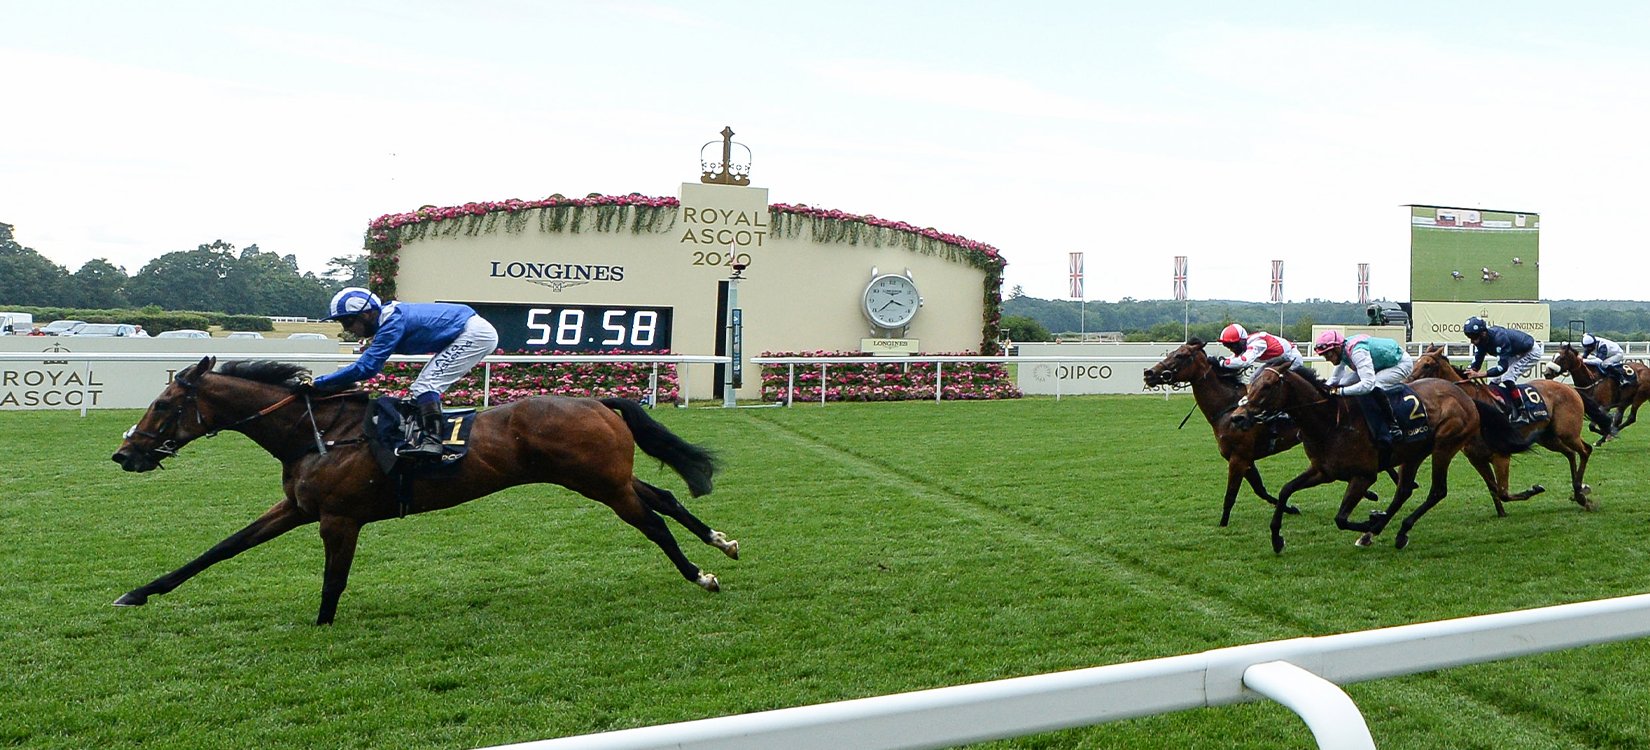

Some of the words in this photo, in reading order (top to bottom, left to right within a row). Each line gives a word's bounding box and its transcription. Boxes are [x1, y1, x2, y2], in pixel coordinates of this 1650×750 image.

[683, 207, 767, 227] ROYAL
[680, 228, 767, 247] ASCOT
[692, 251, 752, 267] 2020
[490, 261, 625, 281] LONGINES
[526, 308, 658, 346] 58.58
[1507, 322, 1544, 330] LONGINES
[2, 370, 103, 386] ROYAL
[1622, 364, 1635, 376] 8
[0, 390, 103, 406] ASCOT
[1525, 386, 1541, 404] 6
[1403, 394, 1426, 420] 2
[442, 416, 465, 445] 1
